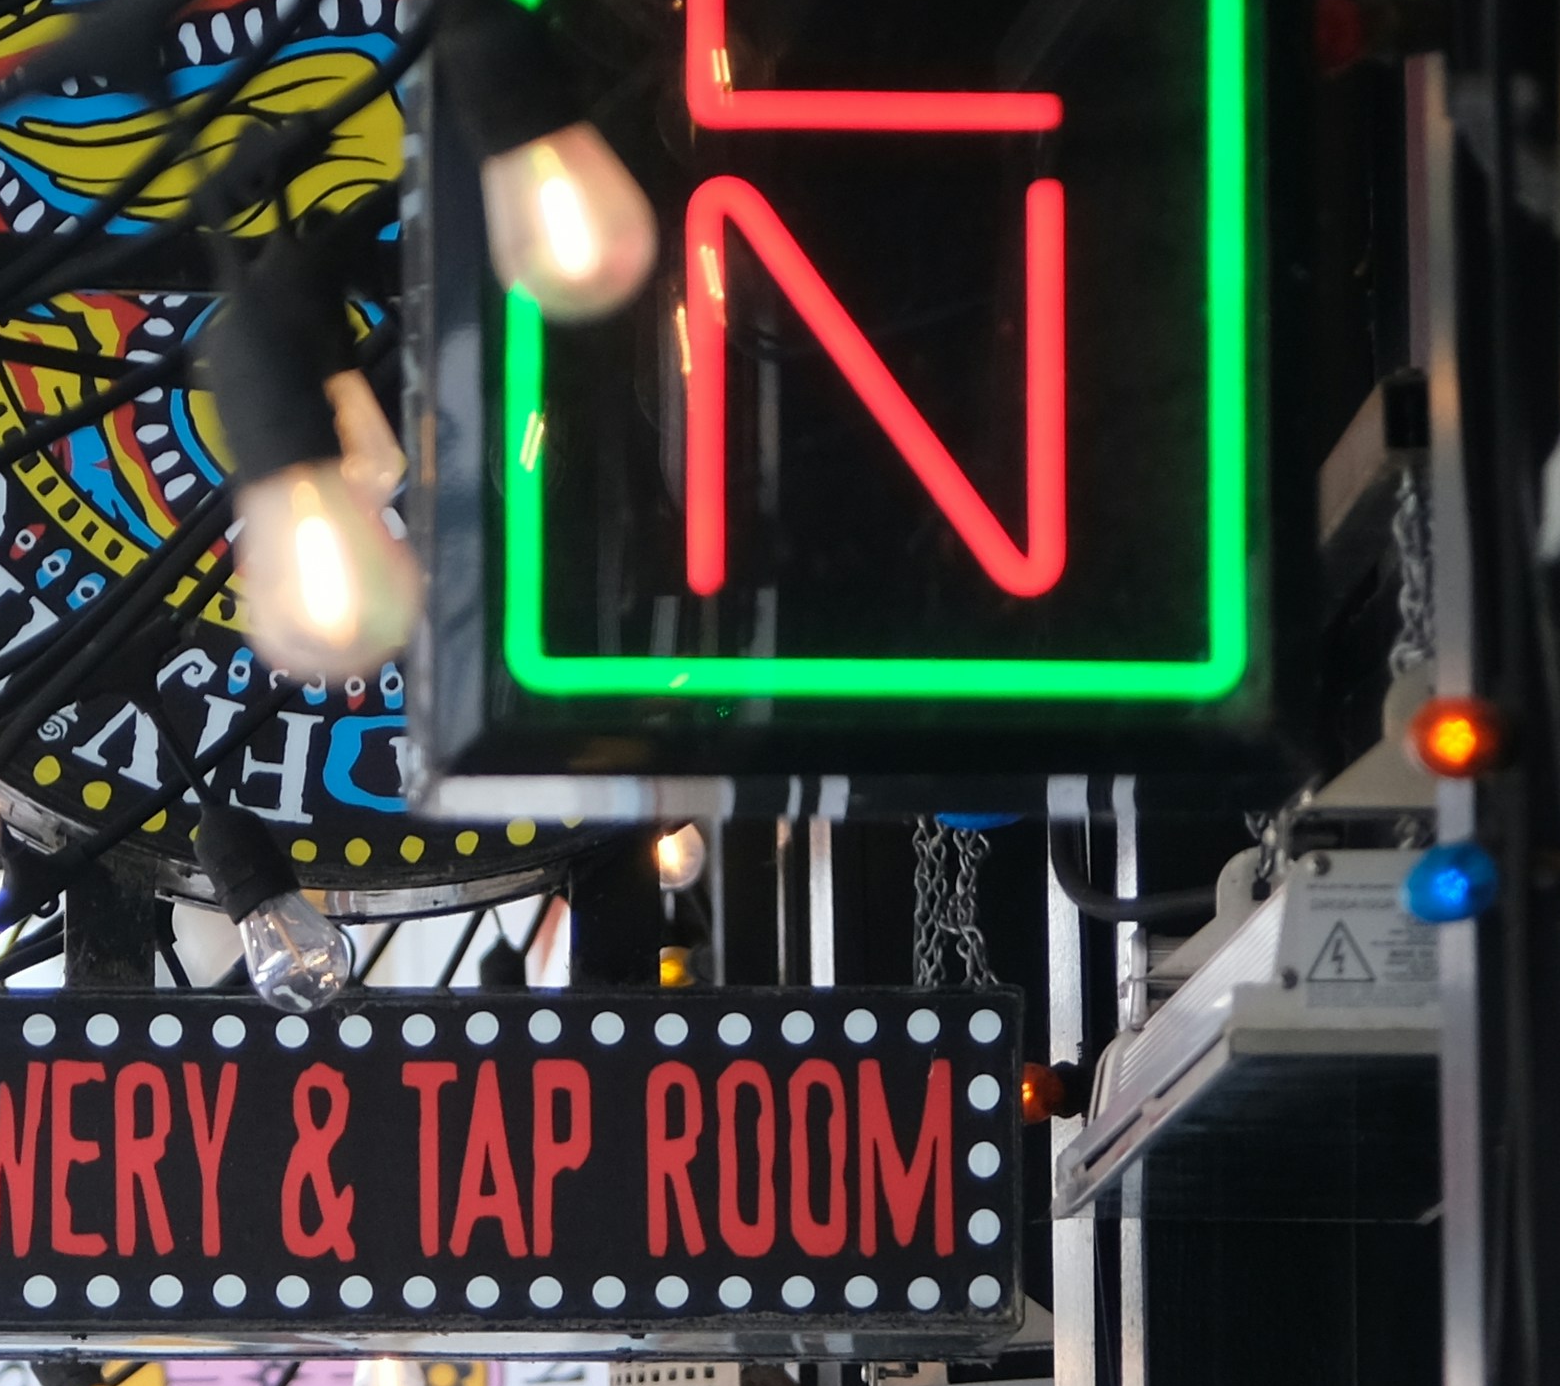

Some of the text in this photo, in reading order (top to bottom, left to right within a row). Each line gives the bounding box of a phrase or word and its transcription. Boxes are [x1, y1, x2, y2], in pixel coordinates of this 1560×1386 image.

[282, 1062, 358, 1263] &
[400, 1058, 593, 1259] TAP
[645, 1057, 956, 1259] ROOM
